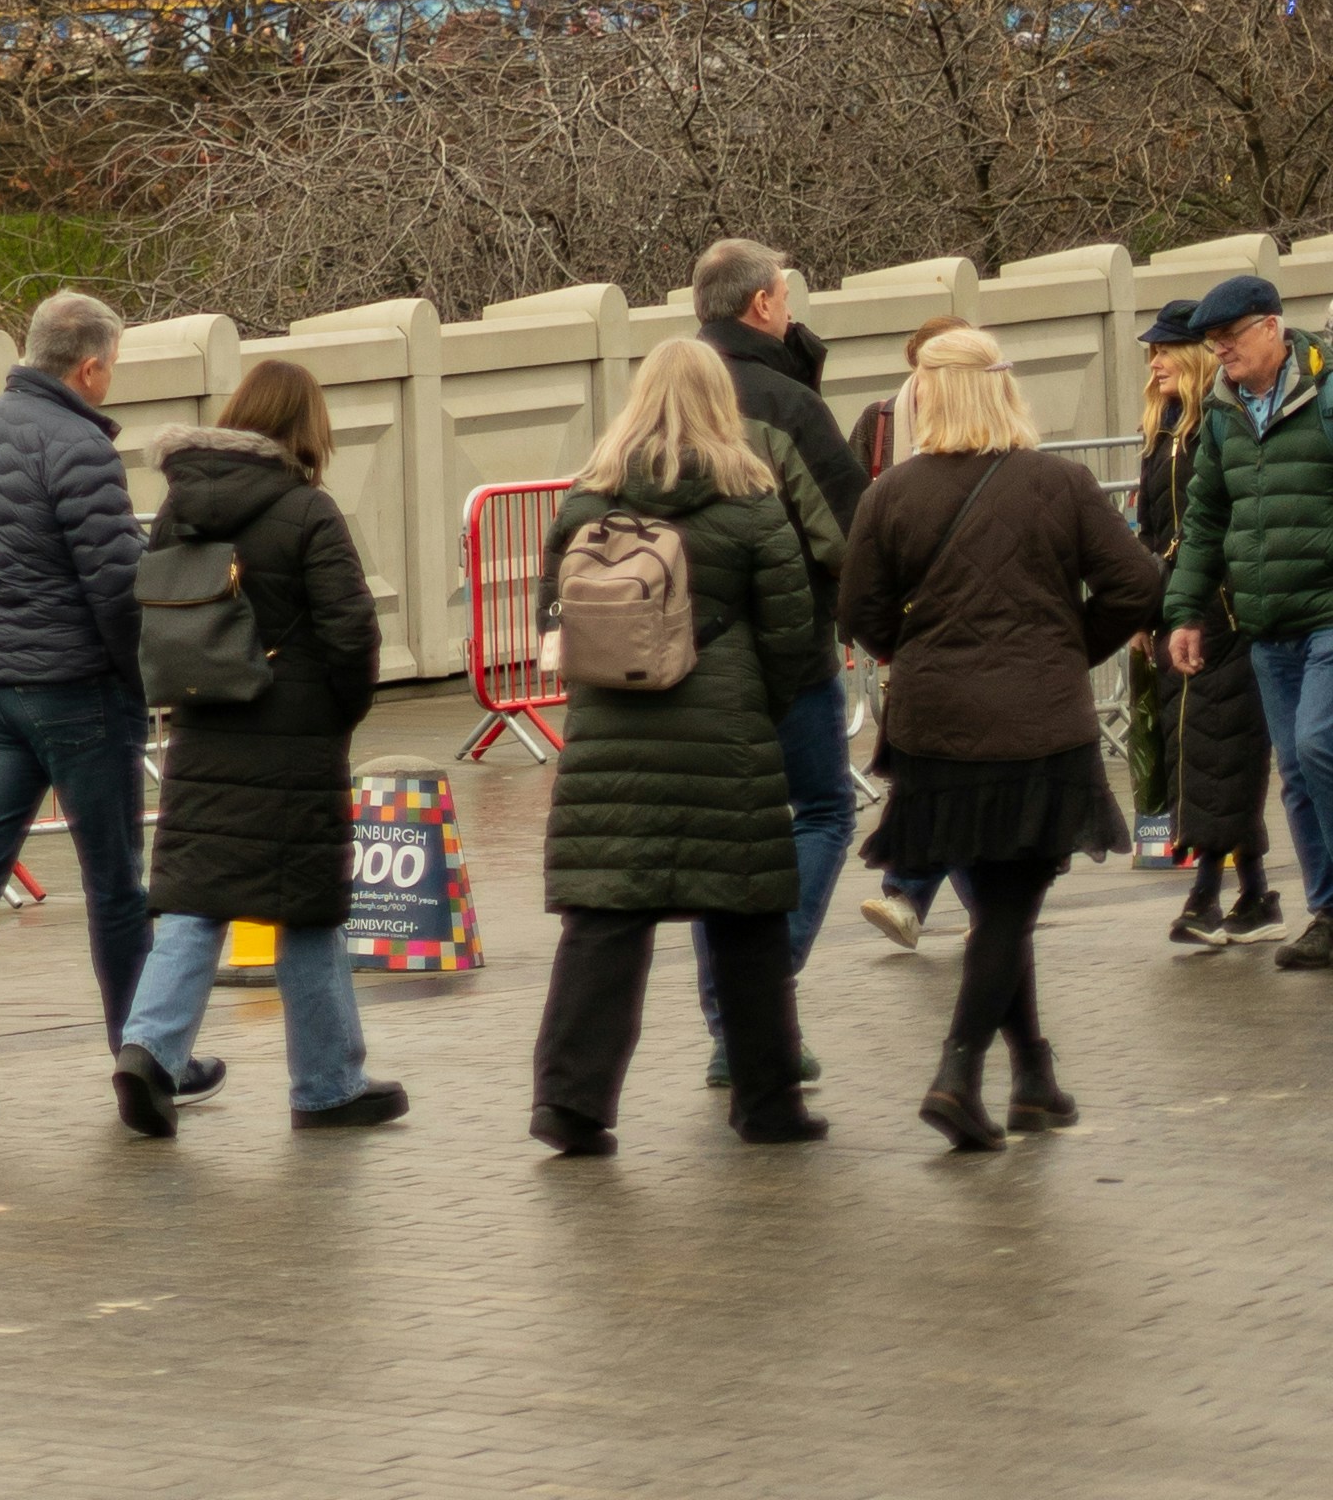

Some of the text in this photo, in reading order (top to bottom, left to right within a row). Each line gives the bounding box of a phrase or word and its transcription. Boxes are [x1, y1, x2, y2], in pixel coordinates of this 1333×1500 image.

[352, 824, 427, 846] DINBURGH
[1139, 826, 1172, 837] EDINBV
[351, 840, 425, 888] 00
[401, 893, 417, 902] 900
